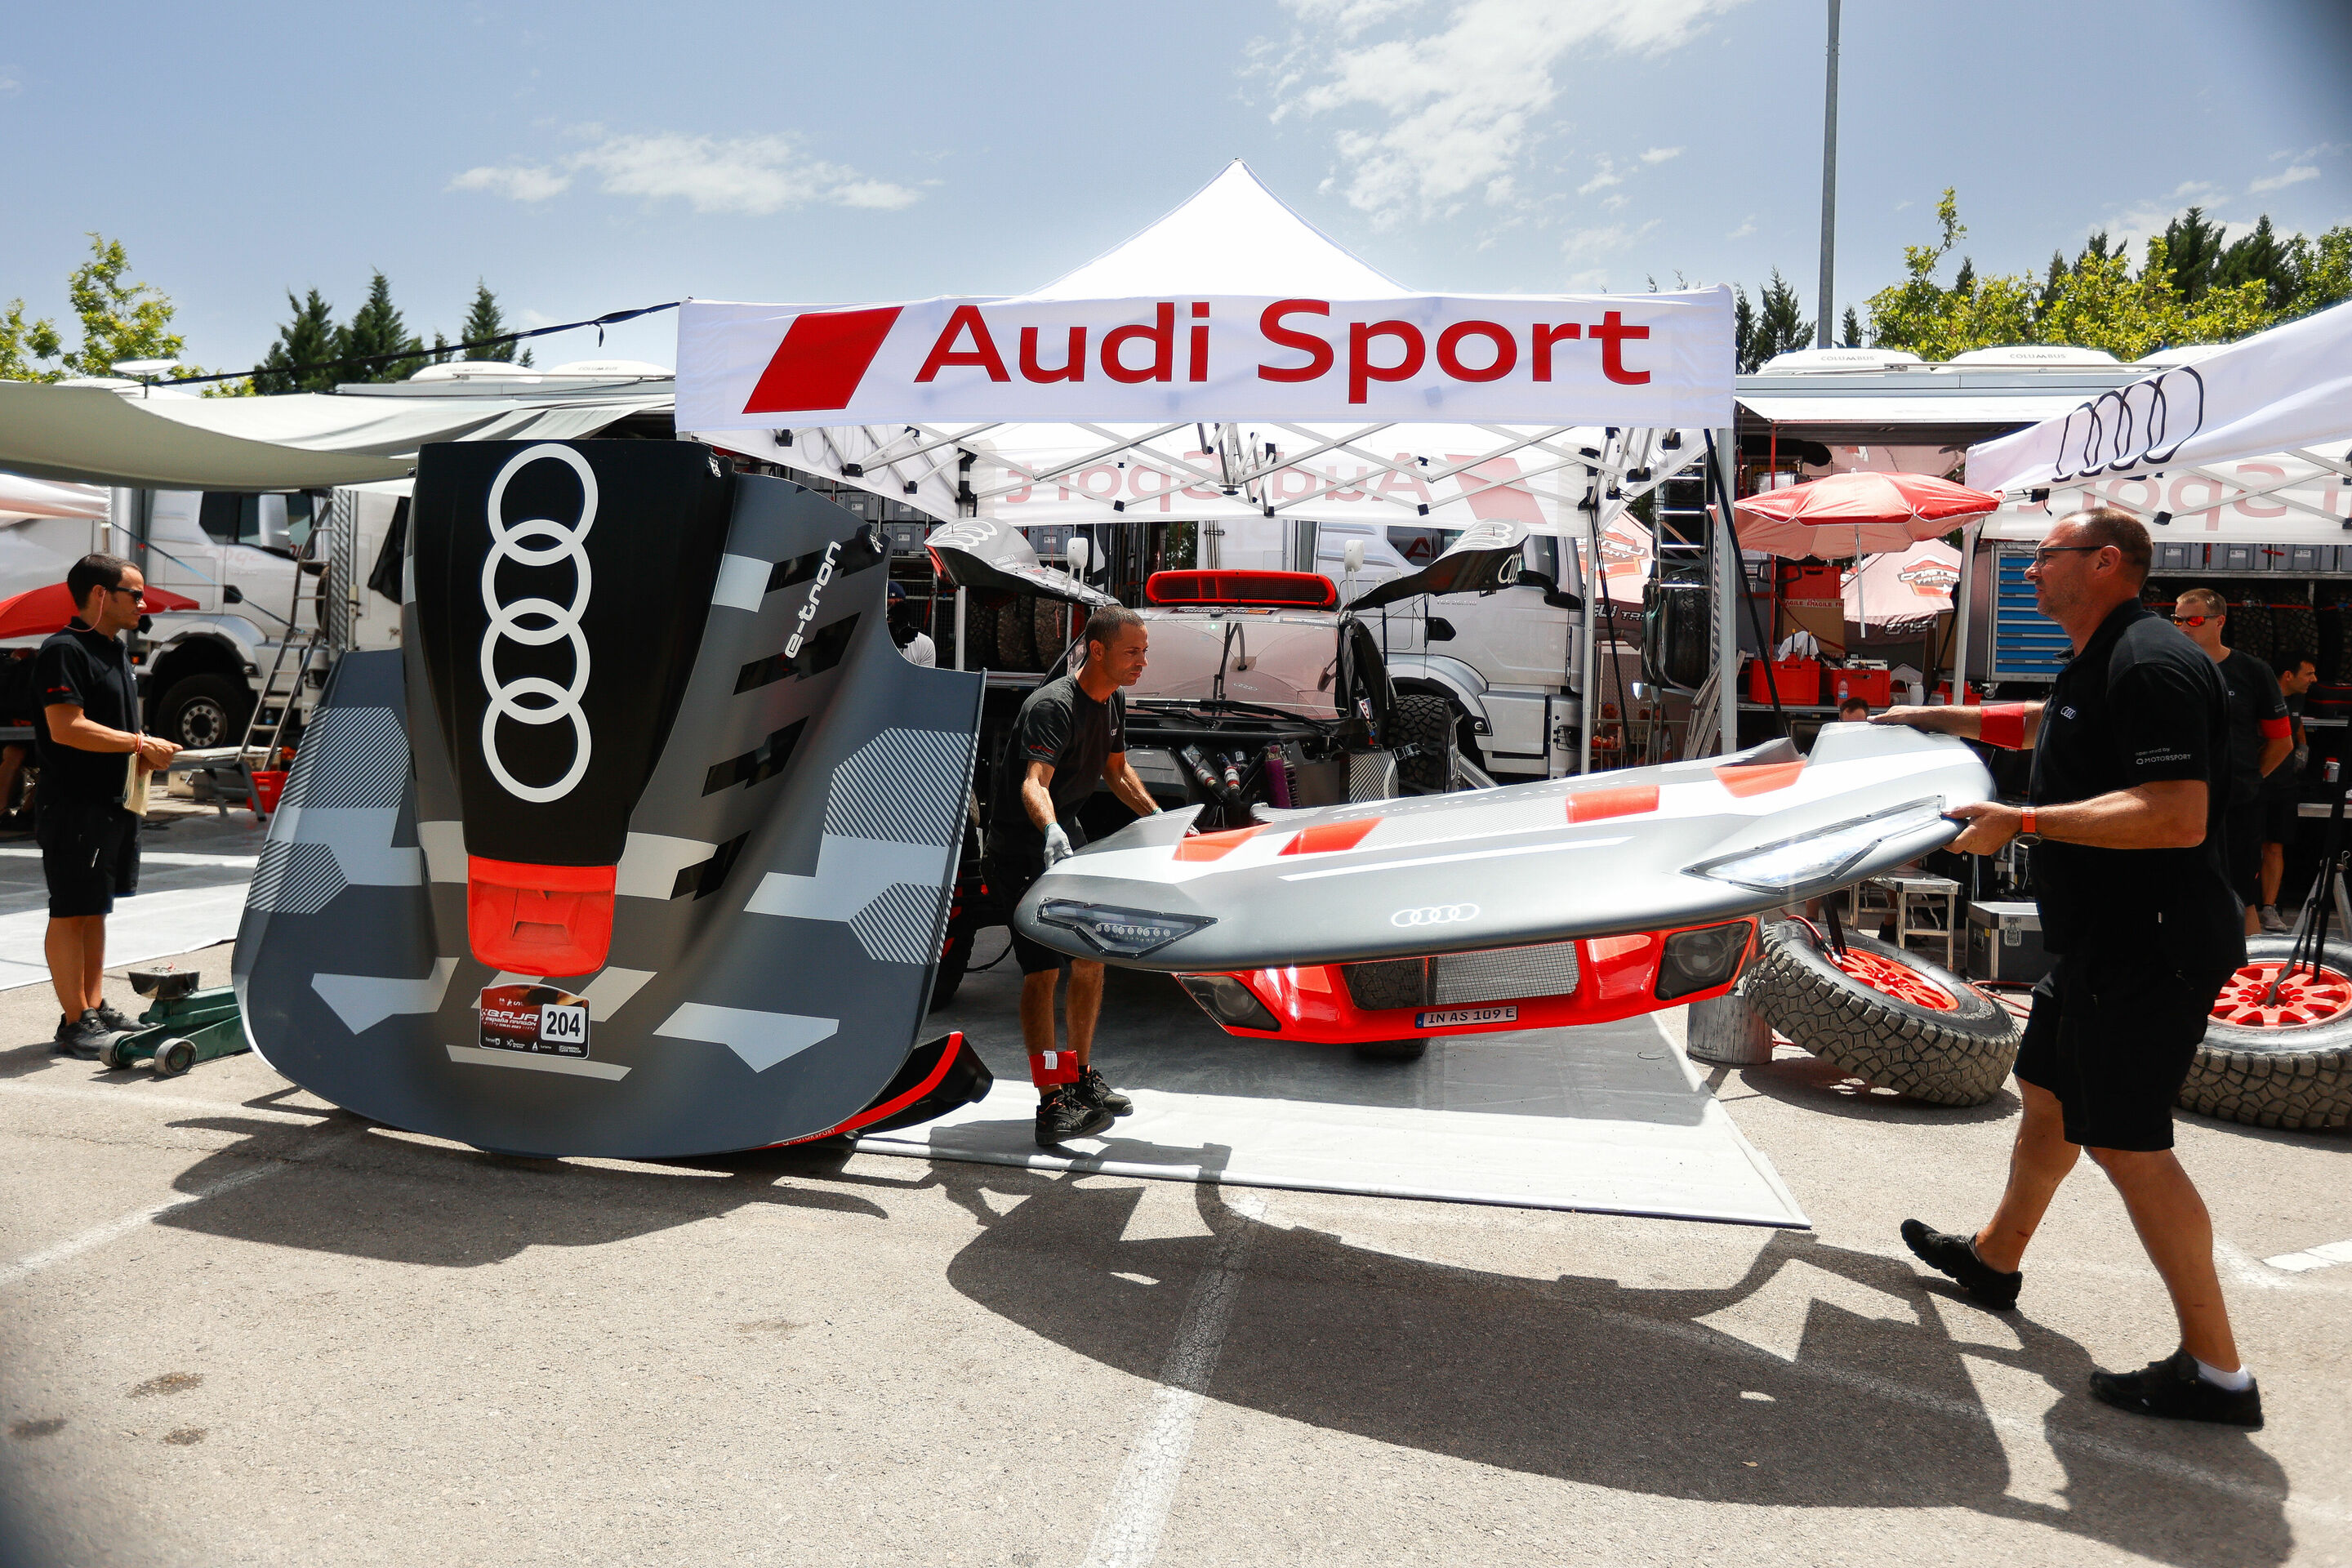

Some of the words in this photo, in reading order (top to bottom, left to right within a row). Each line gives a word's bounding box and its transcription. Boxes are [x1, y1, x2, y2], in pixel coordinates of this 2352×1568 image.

[914, 301, 1209, 384] Audi
[1258, 298, 1650, 403] Sport
[784, 541, 842, 659] e-tron
[2144, 754, 2192, 764] MOTORSPORT
[487, 1009, 539, 1022] BAJA
[546, 1010, 581, 1037] 204
[1450, 1012, 1468, 1022] AS
[1472, 1009, 1501, 1021] 109
[1506, 1008, 1515, 1018] E
